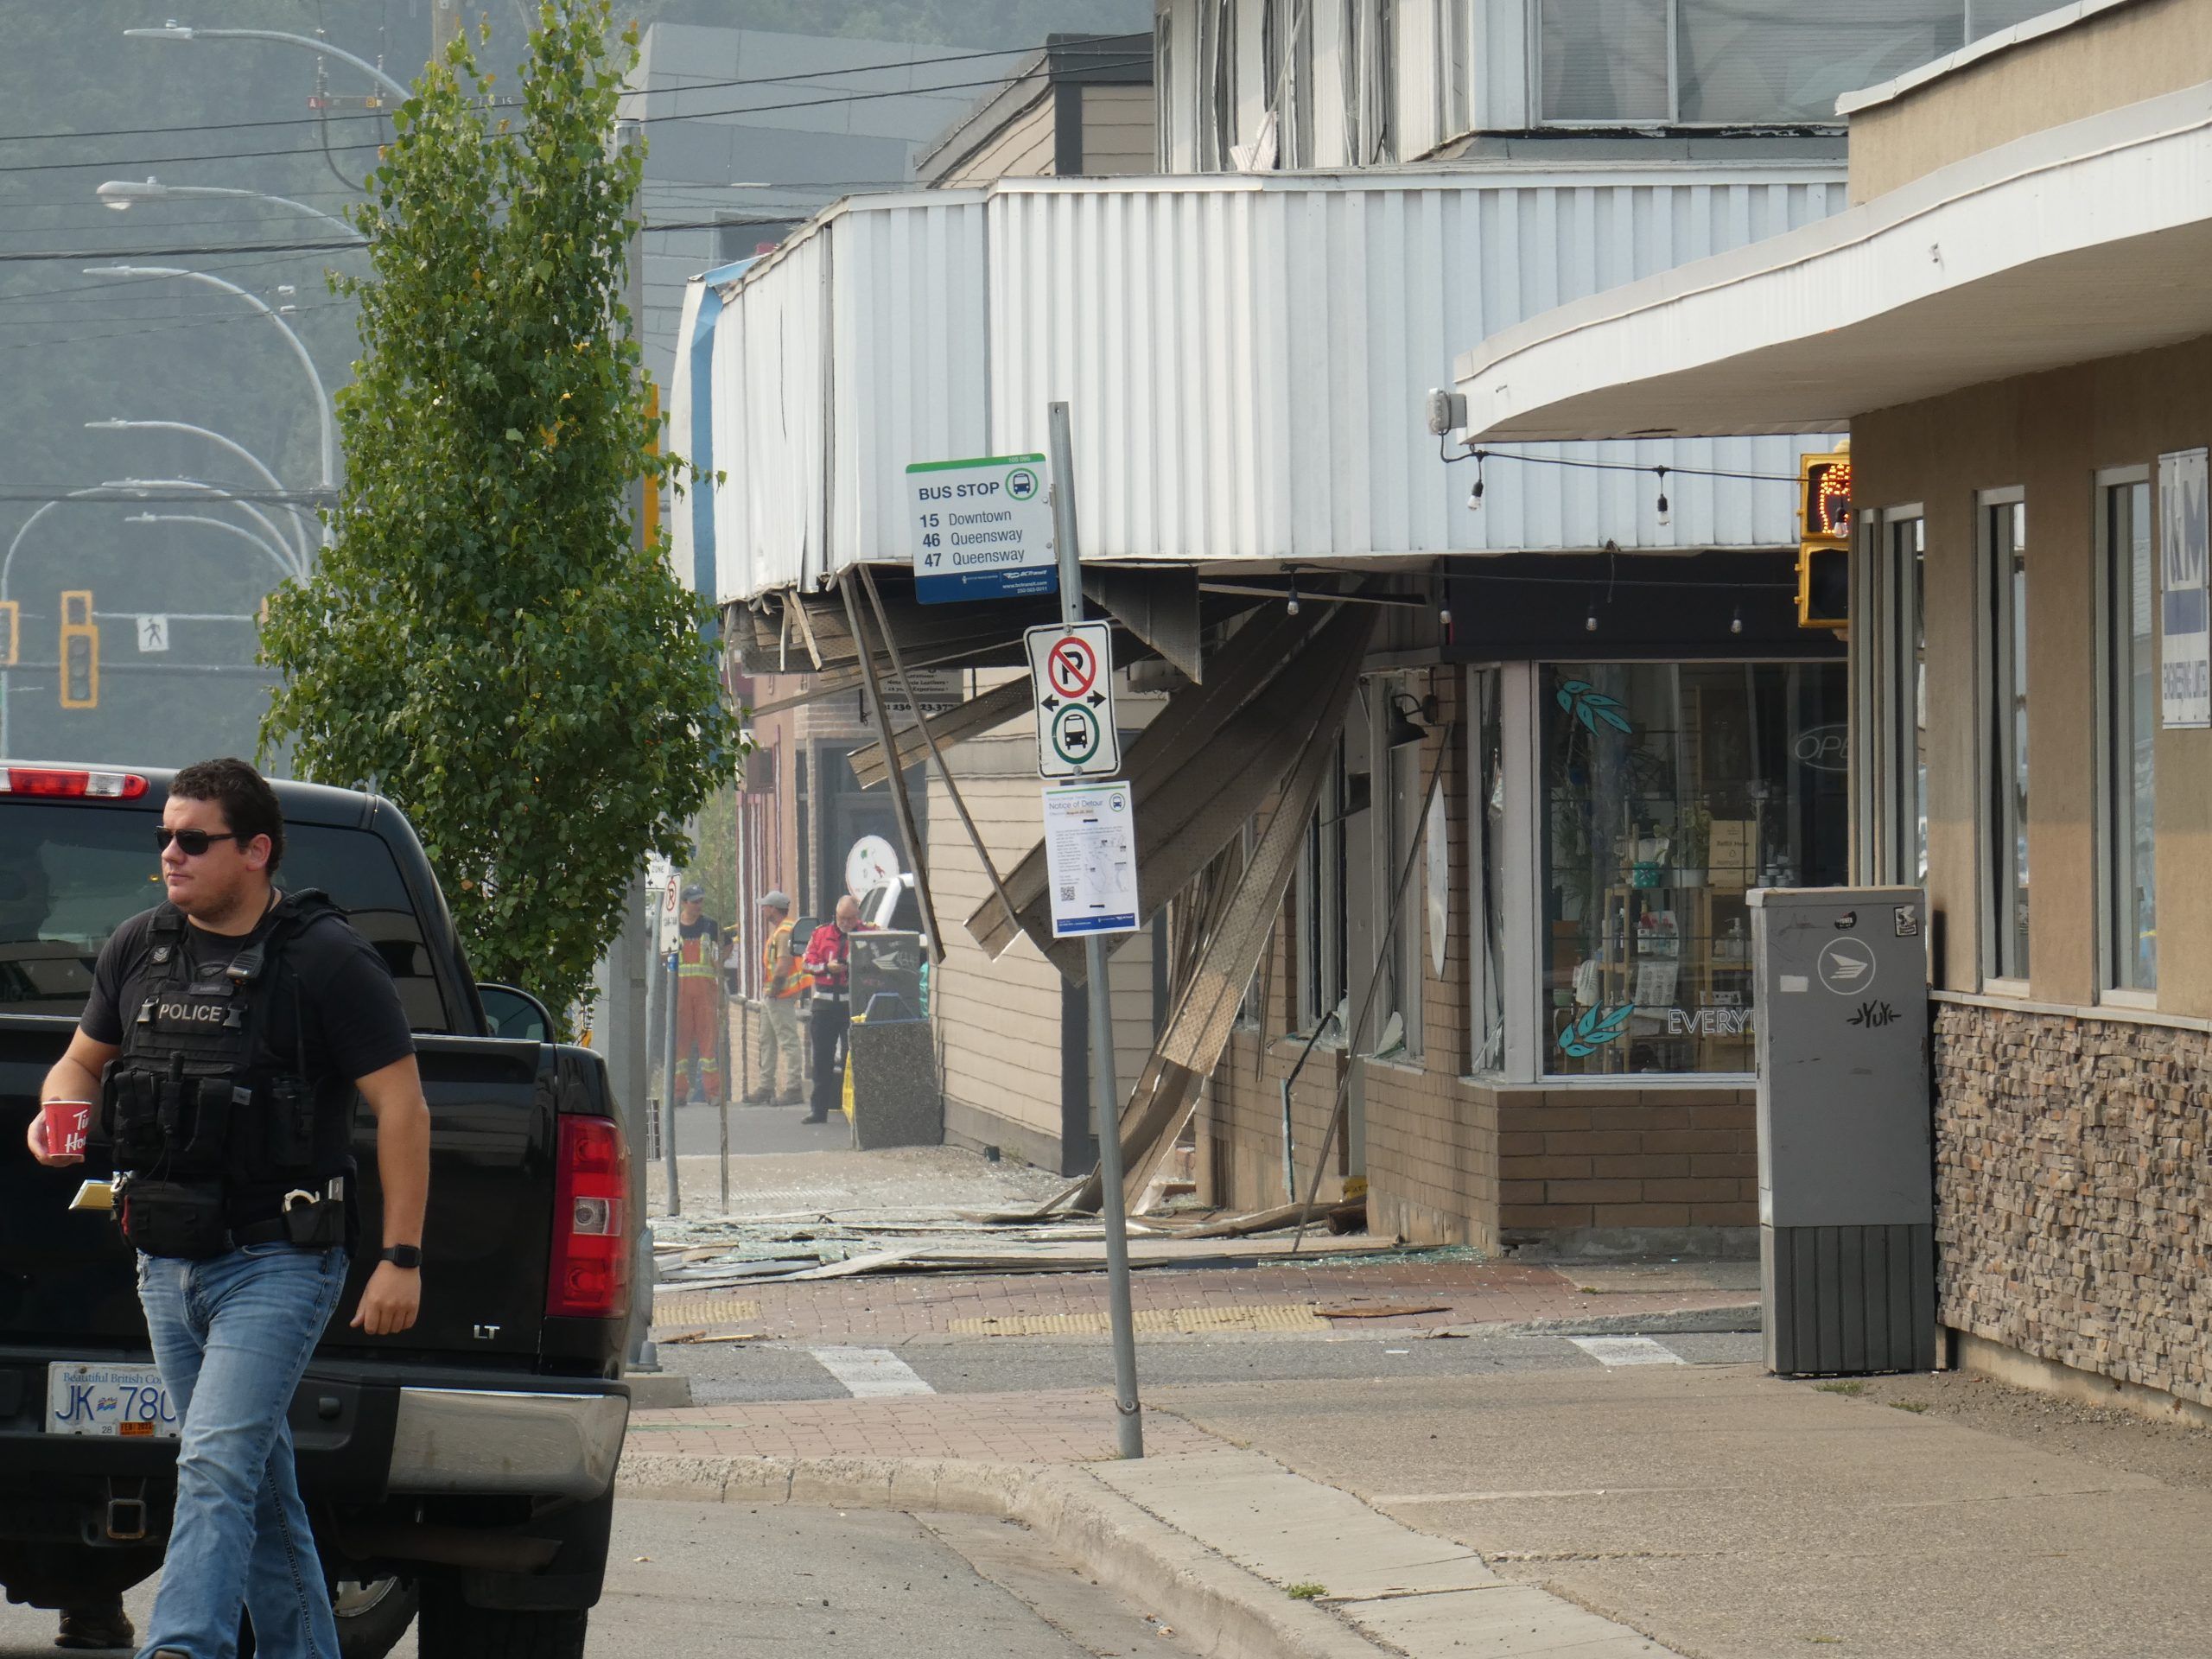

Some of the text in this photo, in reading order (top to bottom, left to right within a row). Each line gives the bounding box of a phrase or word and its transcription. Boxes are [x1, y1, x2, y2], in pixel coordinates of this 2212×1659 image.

[918, 481, 1000, 500] BUS STOP
[919, 511, 1012, 528] 15 Downtown
[923, 529, 1023, 548] 46 Queensway
[925, 550, 1025, 568] 47 Queensway
[159, 1003, 223, 1022] POLICE
[1668, 1009, 1756, 1033] EVERY
[474, 1325, 500, 1339] LT
[63, 1372, 162, 1383] Beautiful British Co
[55, 1385, 95, 1421] JK
